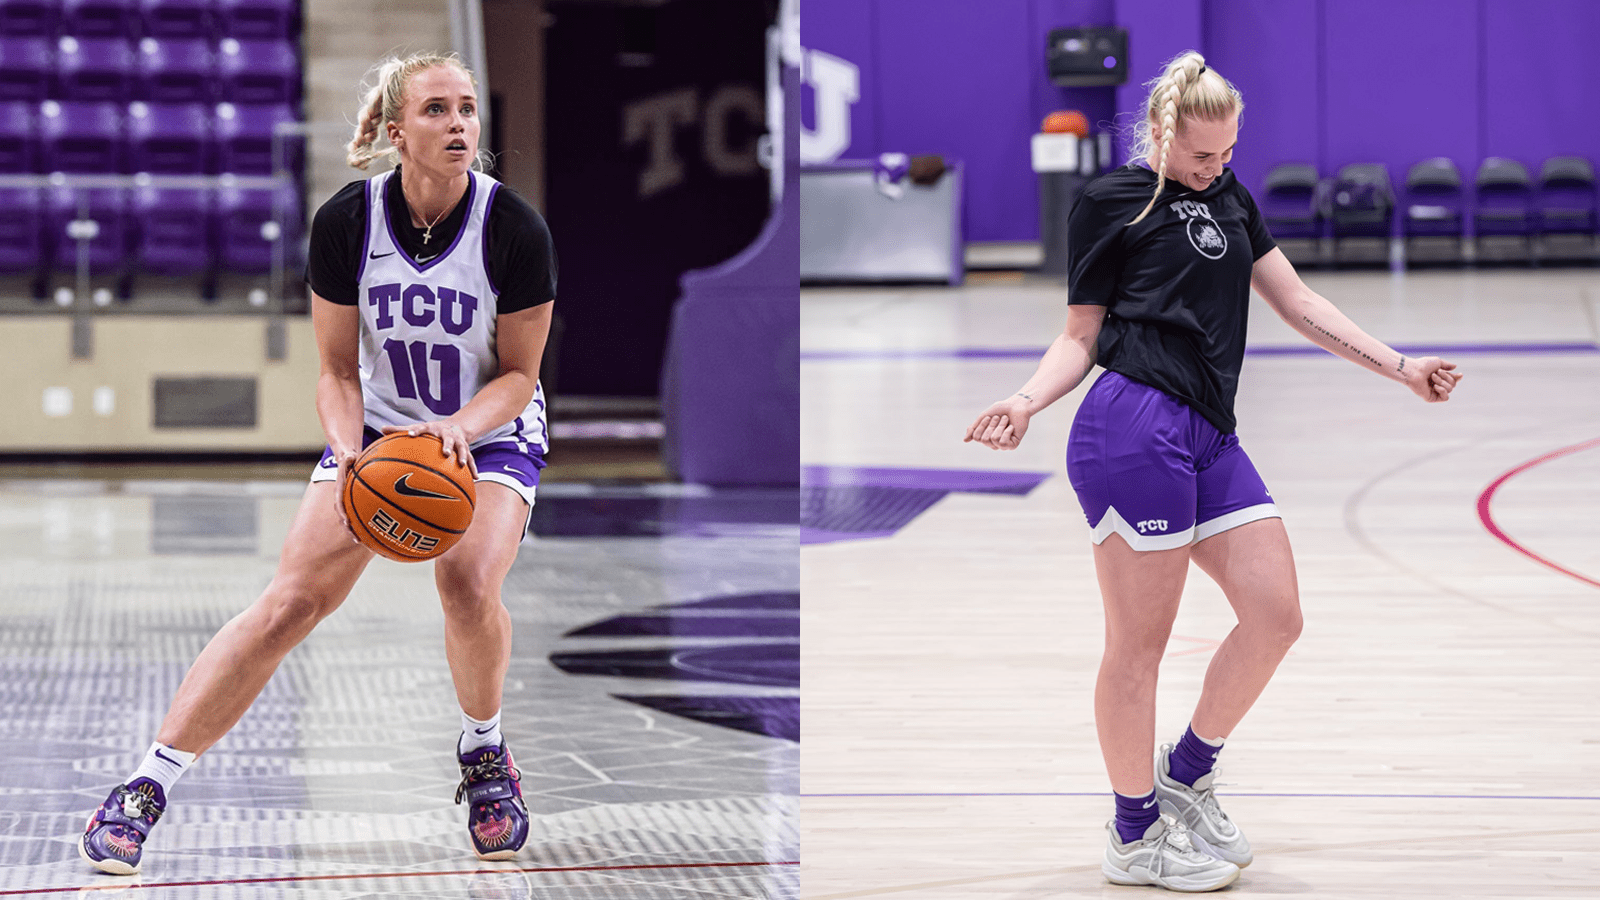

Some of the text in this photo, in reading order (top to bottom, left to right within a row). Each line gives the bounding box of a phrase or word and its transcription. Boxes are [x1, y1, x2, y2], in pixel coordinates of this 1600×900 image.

[1169, 200, 1212, 219] TCU
[368, 283, 478, 334] TCU
[1303, 316, 1314, 326] THE
[1314, 325, 1341, 342] JOURNEY
[1350, 345, 1361, 355] THE
[1362, 353, 1382, 367] DREAM
[382, 337, 461, 416] 10
[370, 508, 440, 551] ELITE
[1137, 519, 1169, 533] TCU
